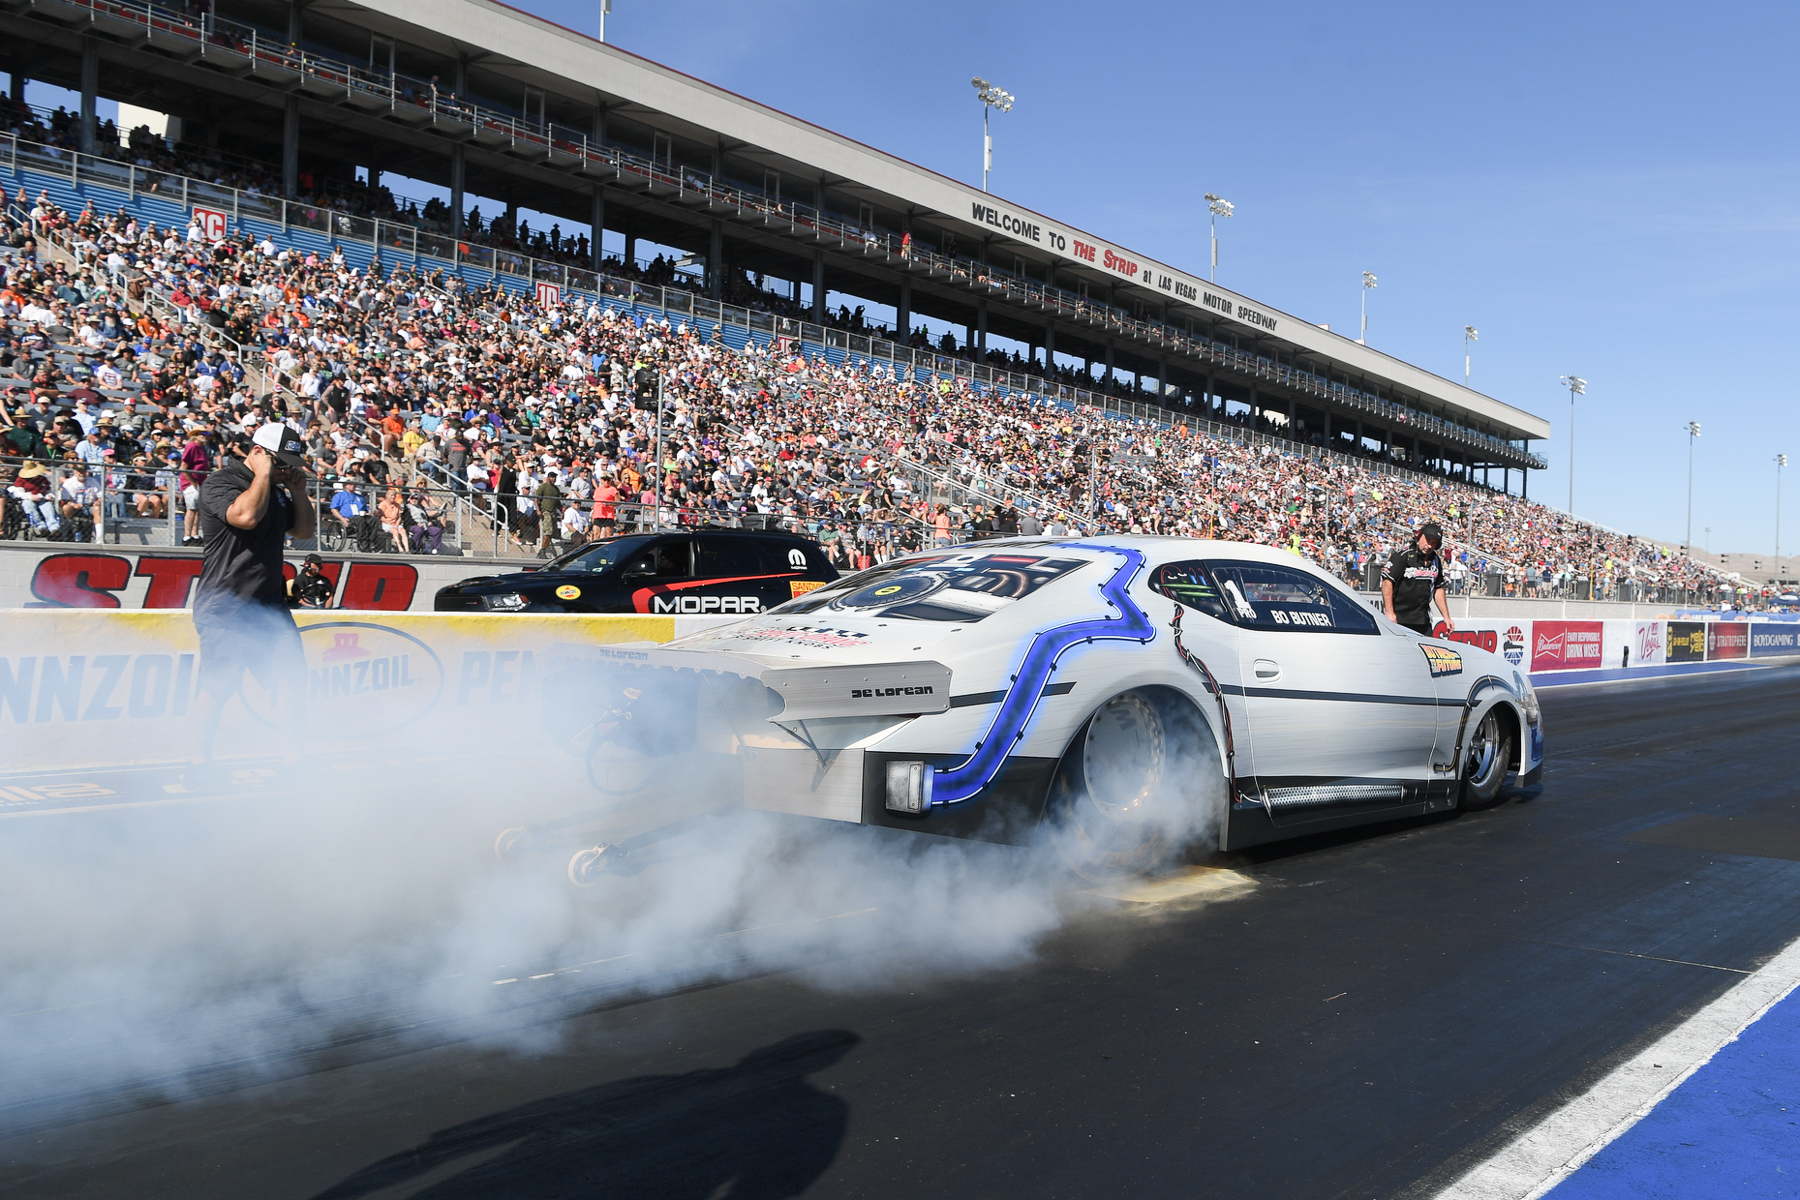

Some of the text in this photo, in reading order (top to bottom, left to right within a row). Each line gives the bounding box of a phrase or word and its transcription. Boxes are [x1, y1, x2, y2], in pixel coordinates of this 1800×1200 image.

[196, 211, 223, 241] 1C
[972, 202, 1040, 242] WELCOME
[1049, 231, 1066, 251] TO
[1073, 240, 1096, 262] THE
[1103, 249, 1138, 277] STRIP
[1158, 275, 1172, 291] LAS
[1175, 281, 1197, 301] VEGAS
[1203, 291, 1232, 315] MOTOR
[1238, 305, 1277, 331] SPEEDWAY
[1223, 580, 1249, 609] 1
[654, 596, 760, 613] MOPAR
[1238, 607, 1257, 620] PRO
[1270, 610, 1332, 627] BO BUTNER
[1537, 639, 1562, 651] Budweiser
[1717, 635, 1747, 648] STRATOSPHERE
[1567, 644, 1583, 658] DRINK
